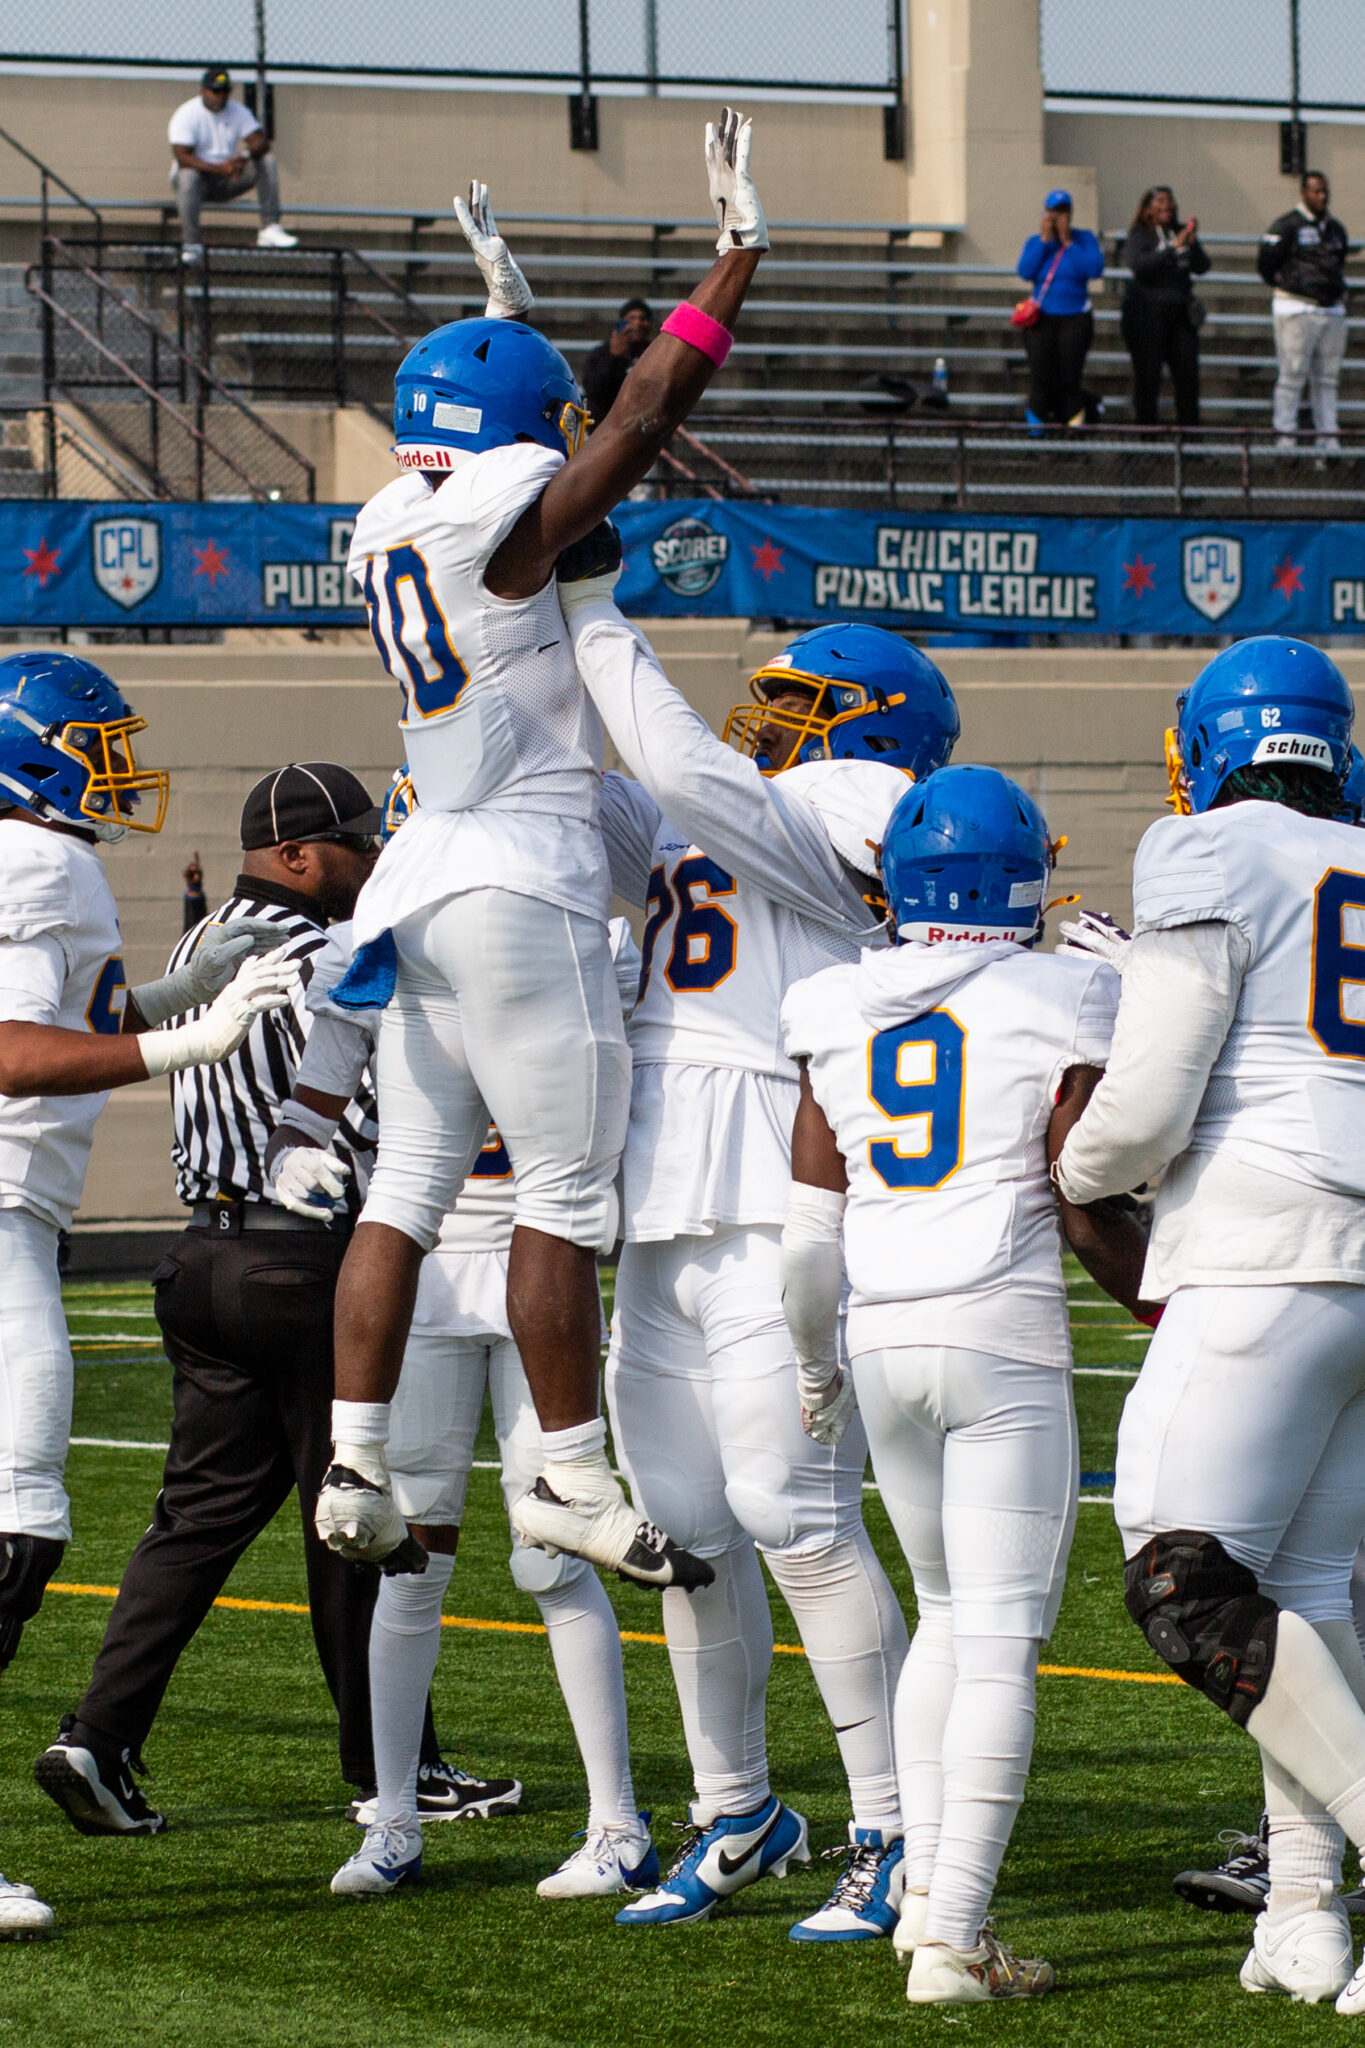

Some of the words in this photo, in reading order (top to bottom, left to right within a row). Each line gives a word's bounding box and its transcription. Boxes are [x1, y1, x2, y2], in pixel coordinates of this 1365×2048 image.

[413, 391, 427, 412] 10
[100, 527, 152, 569] CPL
[653, 535, 728, 567] SCORE!
[877, 528, 1038, 574] CHICAGO
[1190, 543, 1236, 584] CPL
[264, 562, 366, 608] PUBL
[814, 565, 945, 613] PUBLIC
[959, 572, 1096, 618] LEAGUE
[363, 540, 471, 726] 10
[1260, 707, 1282, 728] 62
[1265, 738, 1327, 758] schutt
[949, 892, 959, 910] 9
[634, 852, 739, 1006] 76
[867, 1007, 969, 1192] 9
[220, 1210, 230, 1230] S
